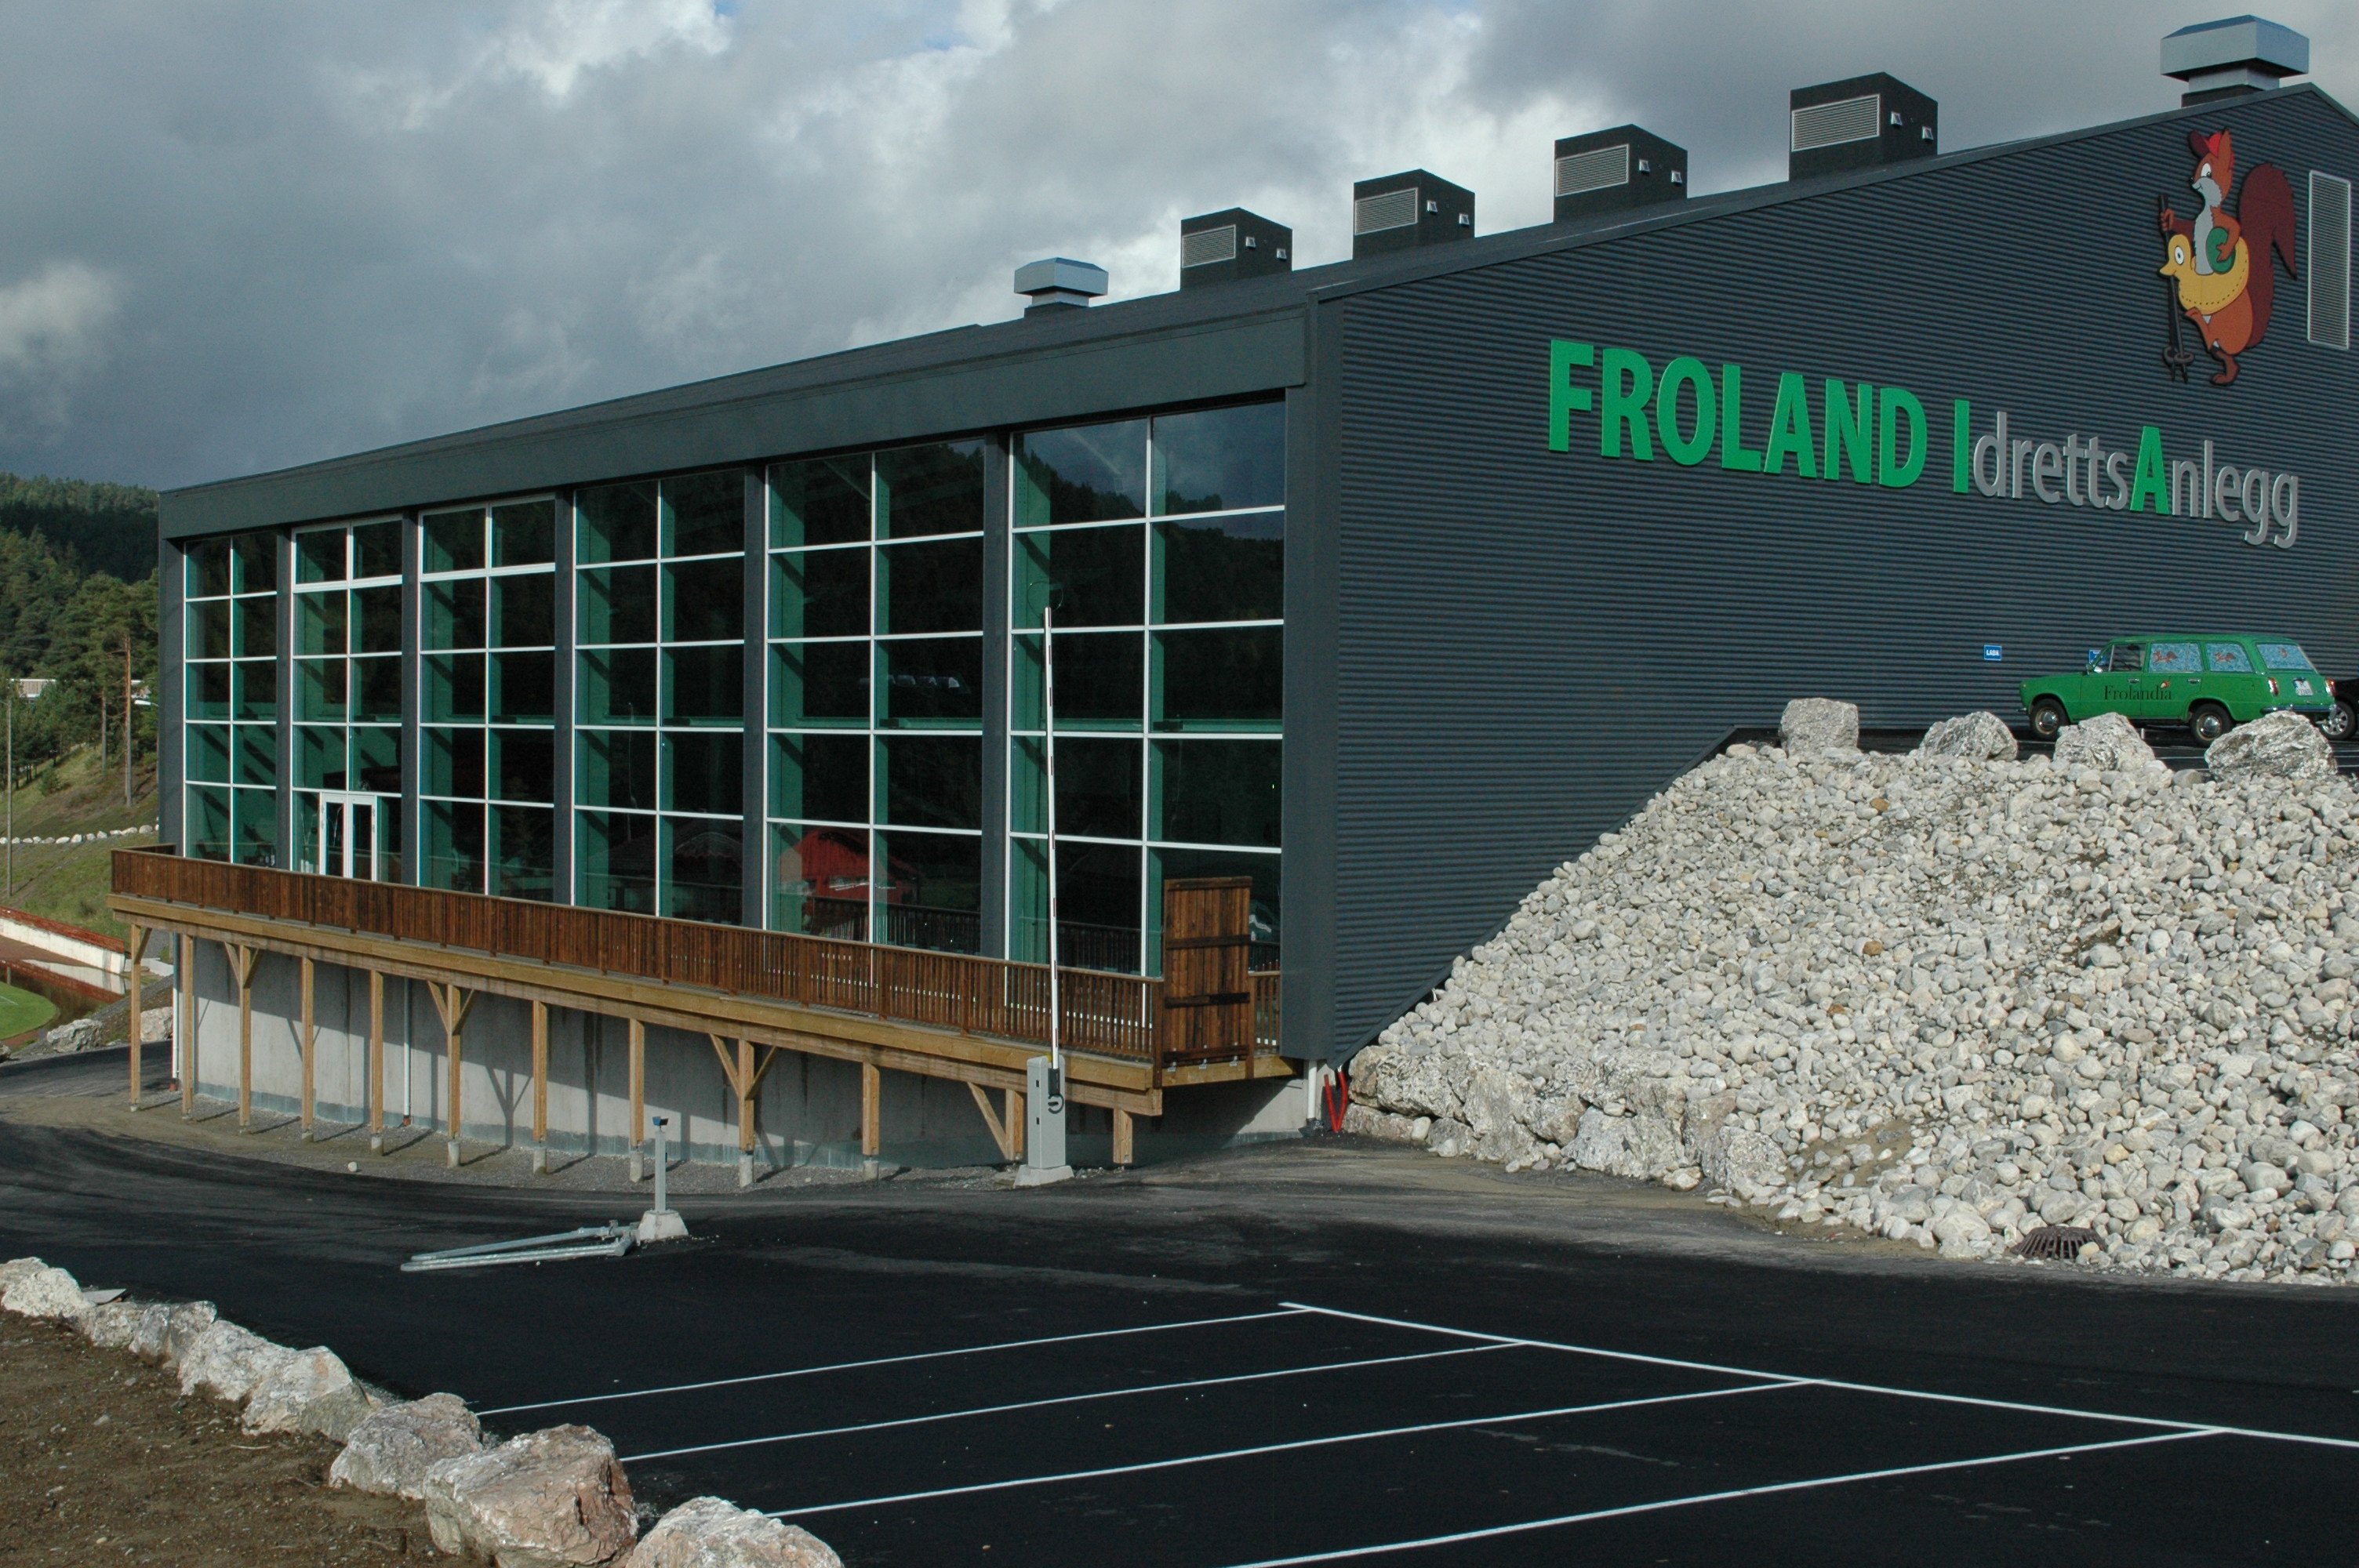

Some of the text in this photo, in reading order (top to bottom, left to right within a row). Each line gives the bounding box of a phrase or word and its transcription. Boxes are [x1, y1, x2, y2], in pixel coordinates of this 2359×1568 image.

[1548, 339, 2299, 549] FROLAND IdrettsAnlegg
[2104, 684, 2172, 700] Frolandia
